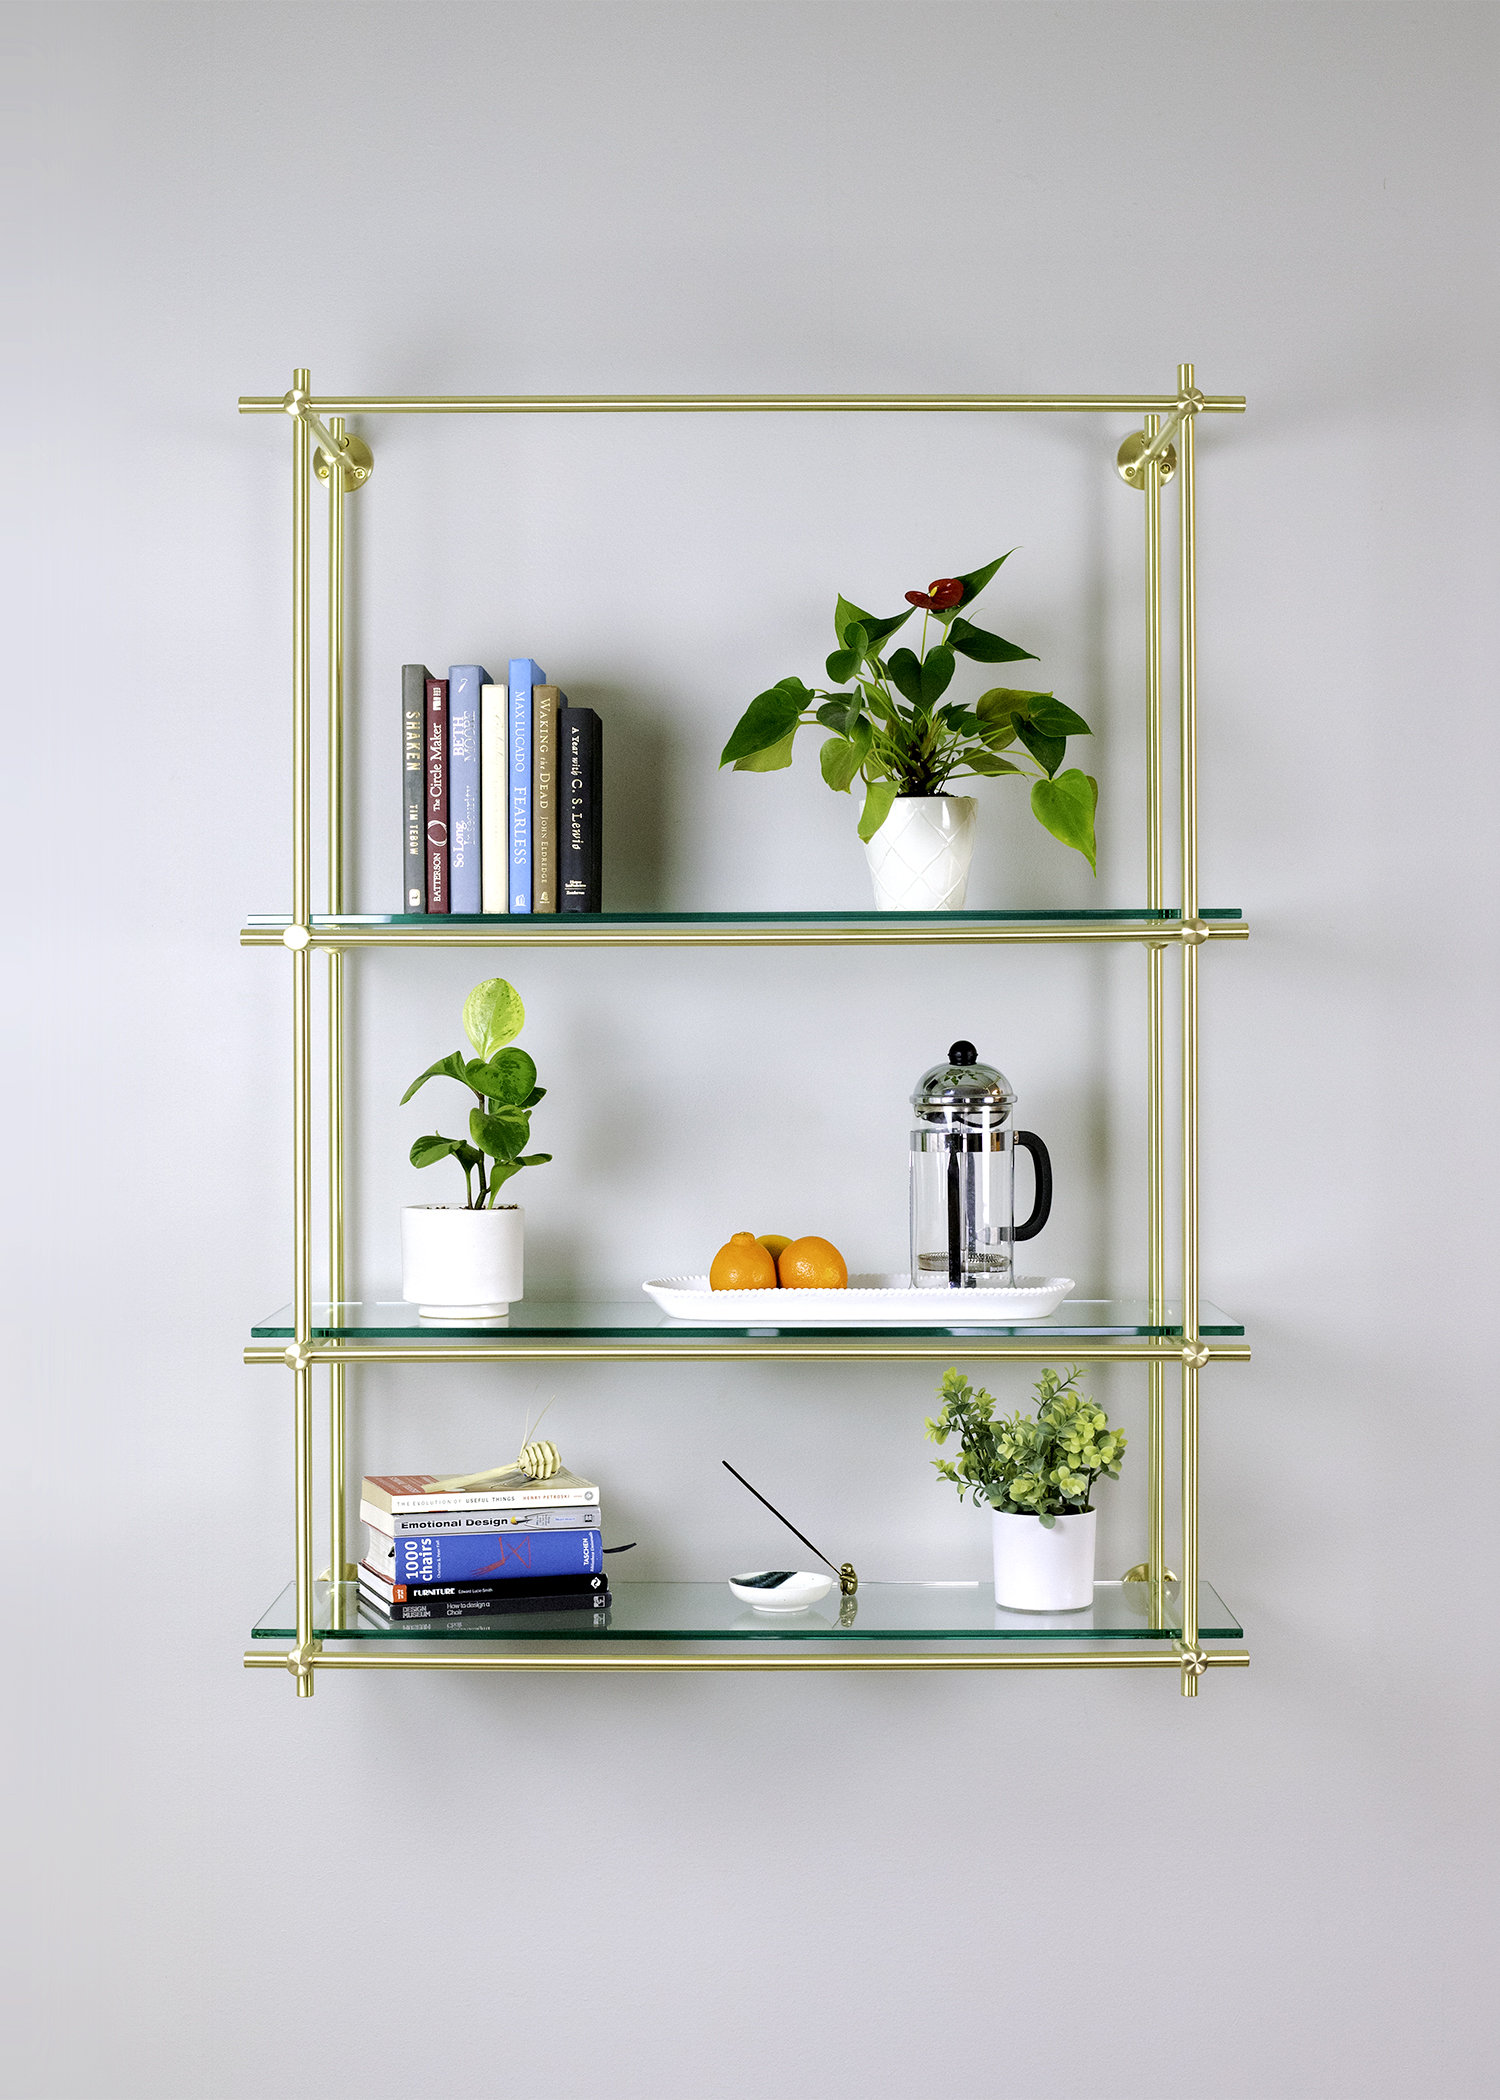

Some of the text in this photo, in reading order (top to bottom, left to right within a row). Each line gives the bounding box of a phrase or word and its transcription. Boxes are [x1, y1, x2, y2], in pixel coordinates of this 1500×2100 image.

[405, 711, 420, 771] SHAKEN
[430, 722, 442, 761] Maker
[453, 716, 465, 756] BETH
[464, 711, 476, 762] MOORE
[515, 691, 526, 772] MAX LUCADO
[539, 698, 551, 753] WAKING
[571, 726, 580, 734] A
[571, 735, 580, 756] Year
[430, 762, 442, 798] Circle
[571, 757, 583, 776] with
[433, 799, 441, 812] The
[539, 773, 551, 809] DEAD
[409, 804, 419, 855] TIM TEBOW
[513, 786, 527, 865] FEARLESS
[571, 813, 584, 850] Lewis
[453, 852, 465, 868] So
[540, 816, 549, 884] JOHN ELDREDGE
[433, 852, 442, 902] BATTERSON
[412, 1499, 452, 1507] EVOLUTION
[401, 1517, 508, 1529] Emotional Design
[404, 1541, 419, 1579] 1000
[418, 1538, 433, 1581] chairs
[582, 1538, 591, 1566] TASCHEN
[413, 1588, 456, 1597] FURNITURE
[466, 1601, 485, 1610] design
[402, 1611, 431, 1619] MUSEUM
